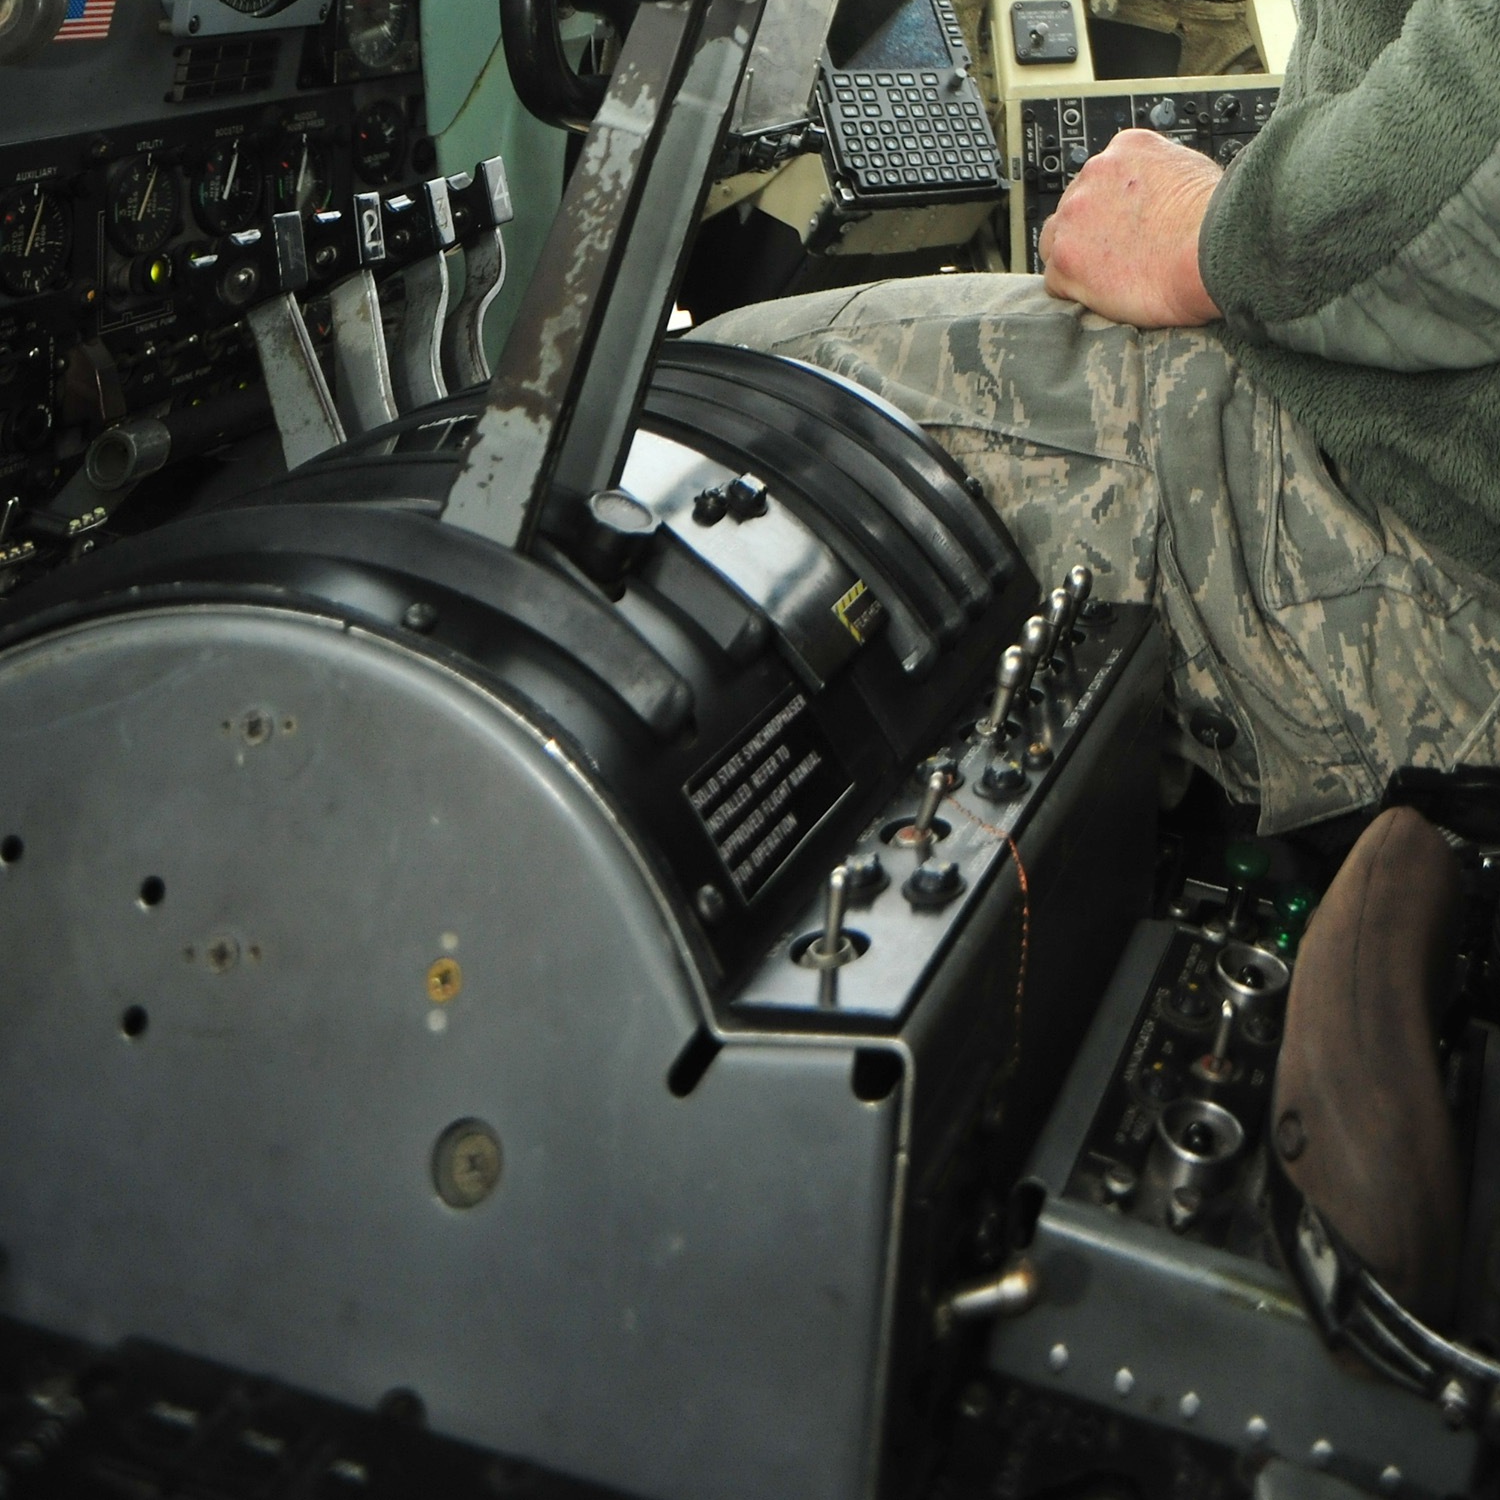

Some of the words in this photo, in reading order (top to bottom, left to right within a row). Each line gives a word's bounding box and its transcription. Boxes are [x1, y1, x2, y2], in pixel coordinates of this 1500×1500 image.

[215, 124, 244, 137] BOOSTER
[136, 139, 164, 151] UTILITY
[15, 166, 58, 182] AUXILIARY
[361, 211, 381, 253] 2
[716, 753, 746, 785] STATE
